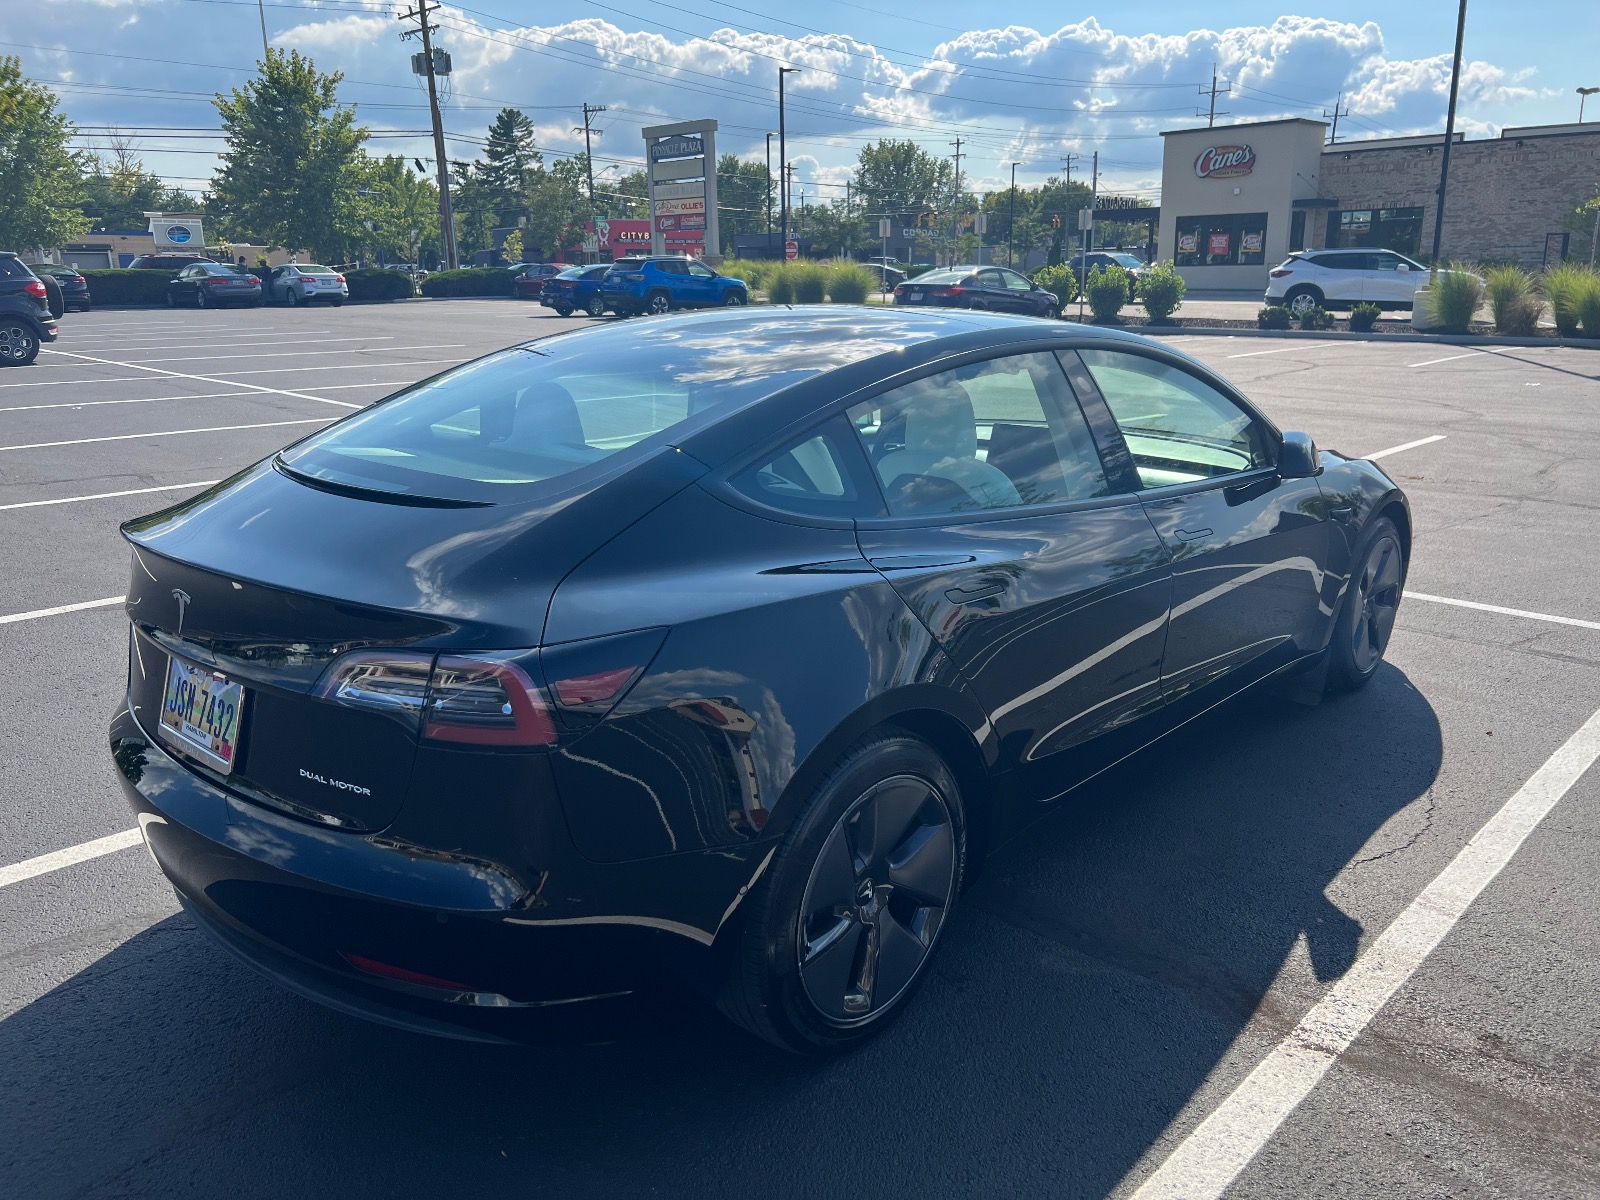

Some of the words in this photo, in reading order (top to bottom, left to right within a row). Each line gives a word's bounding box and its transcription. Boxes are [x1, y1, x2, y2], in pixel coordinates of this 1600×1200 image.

[652, 144, 679, 157] PINNACLE
[680, 141, 702, 153] PLAZA
[1196, 144, 1253, 177] Cane's
[681, 202, 704, 210] OLLIE'S
[198, 689, 234, 745] 7432
[299, 768, 328, 784] DUAL
[329, 778, 371, 796] MOTOR
